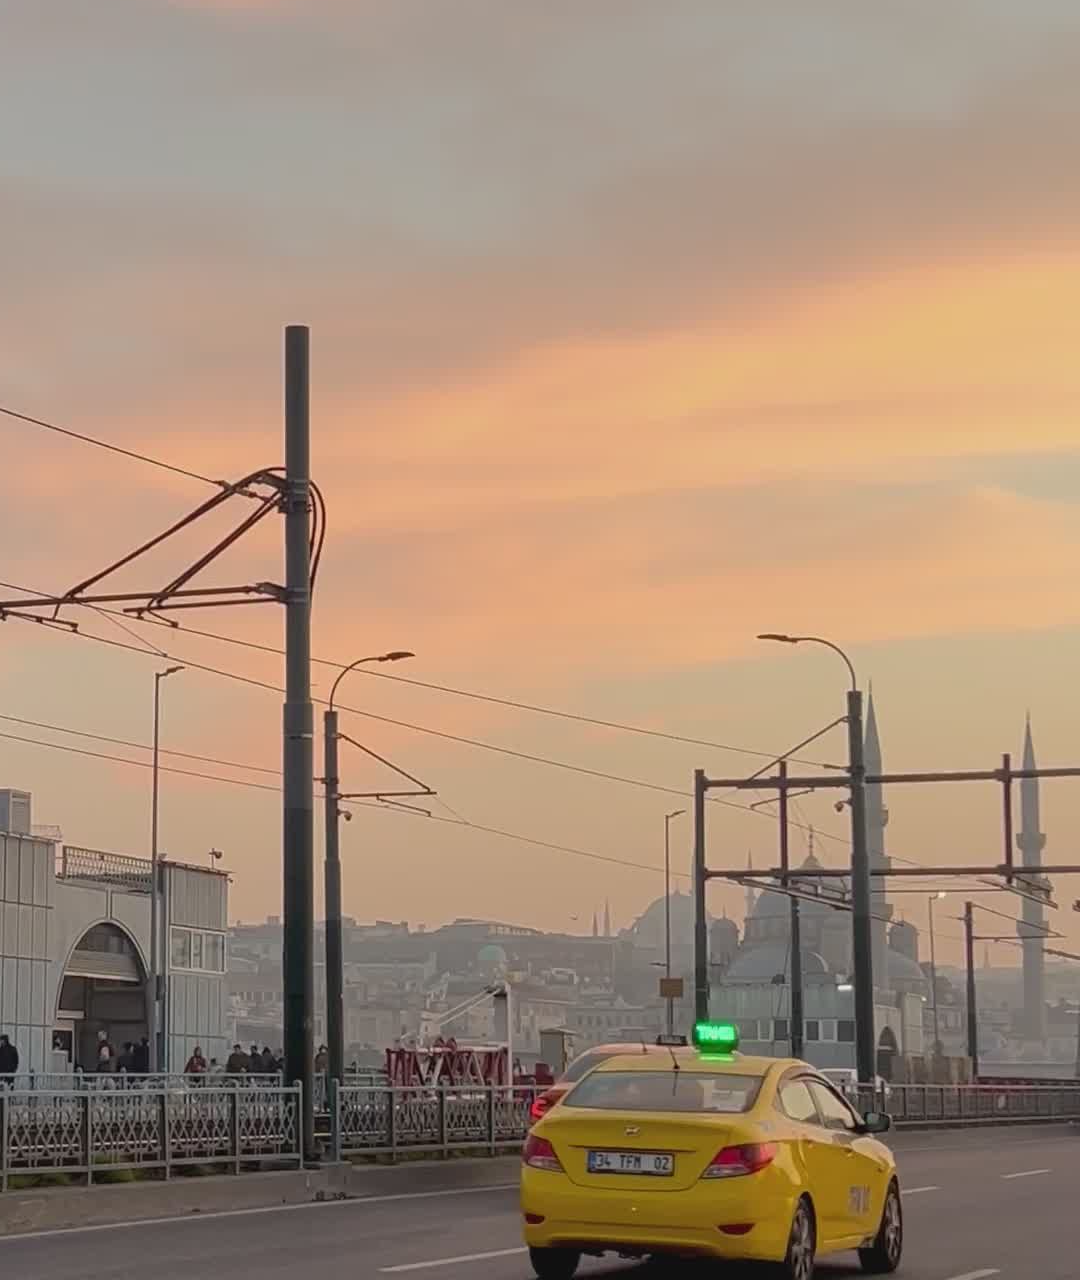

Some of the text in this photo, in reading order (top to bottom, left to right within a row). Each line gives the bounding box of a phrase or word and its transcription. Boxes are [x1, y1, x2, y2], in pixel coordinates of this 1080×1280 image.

[597, 1153, 669, 1170] 34 TFM 02
